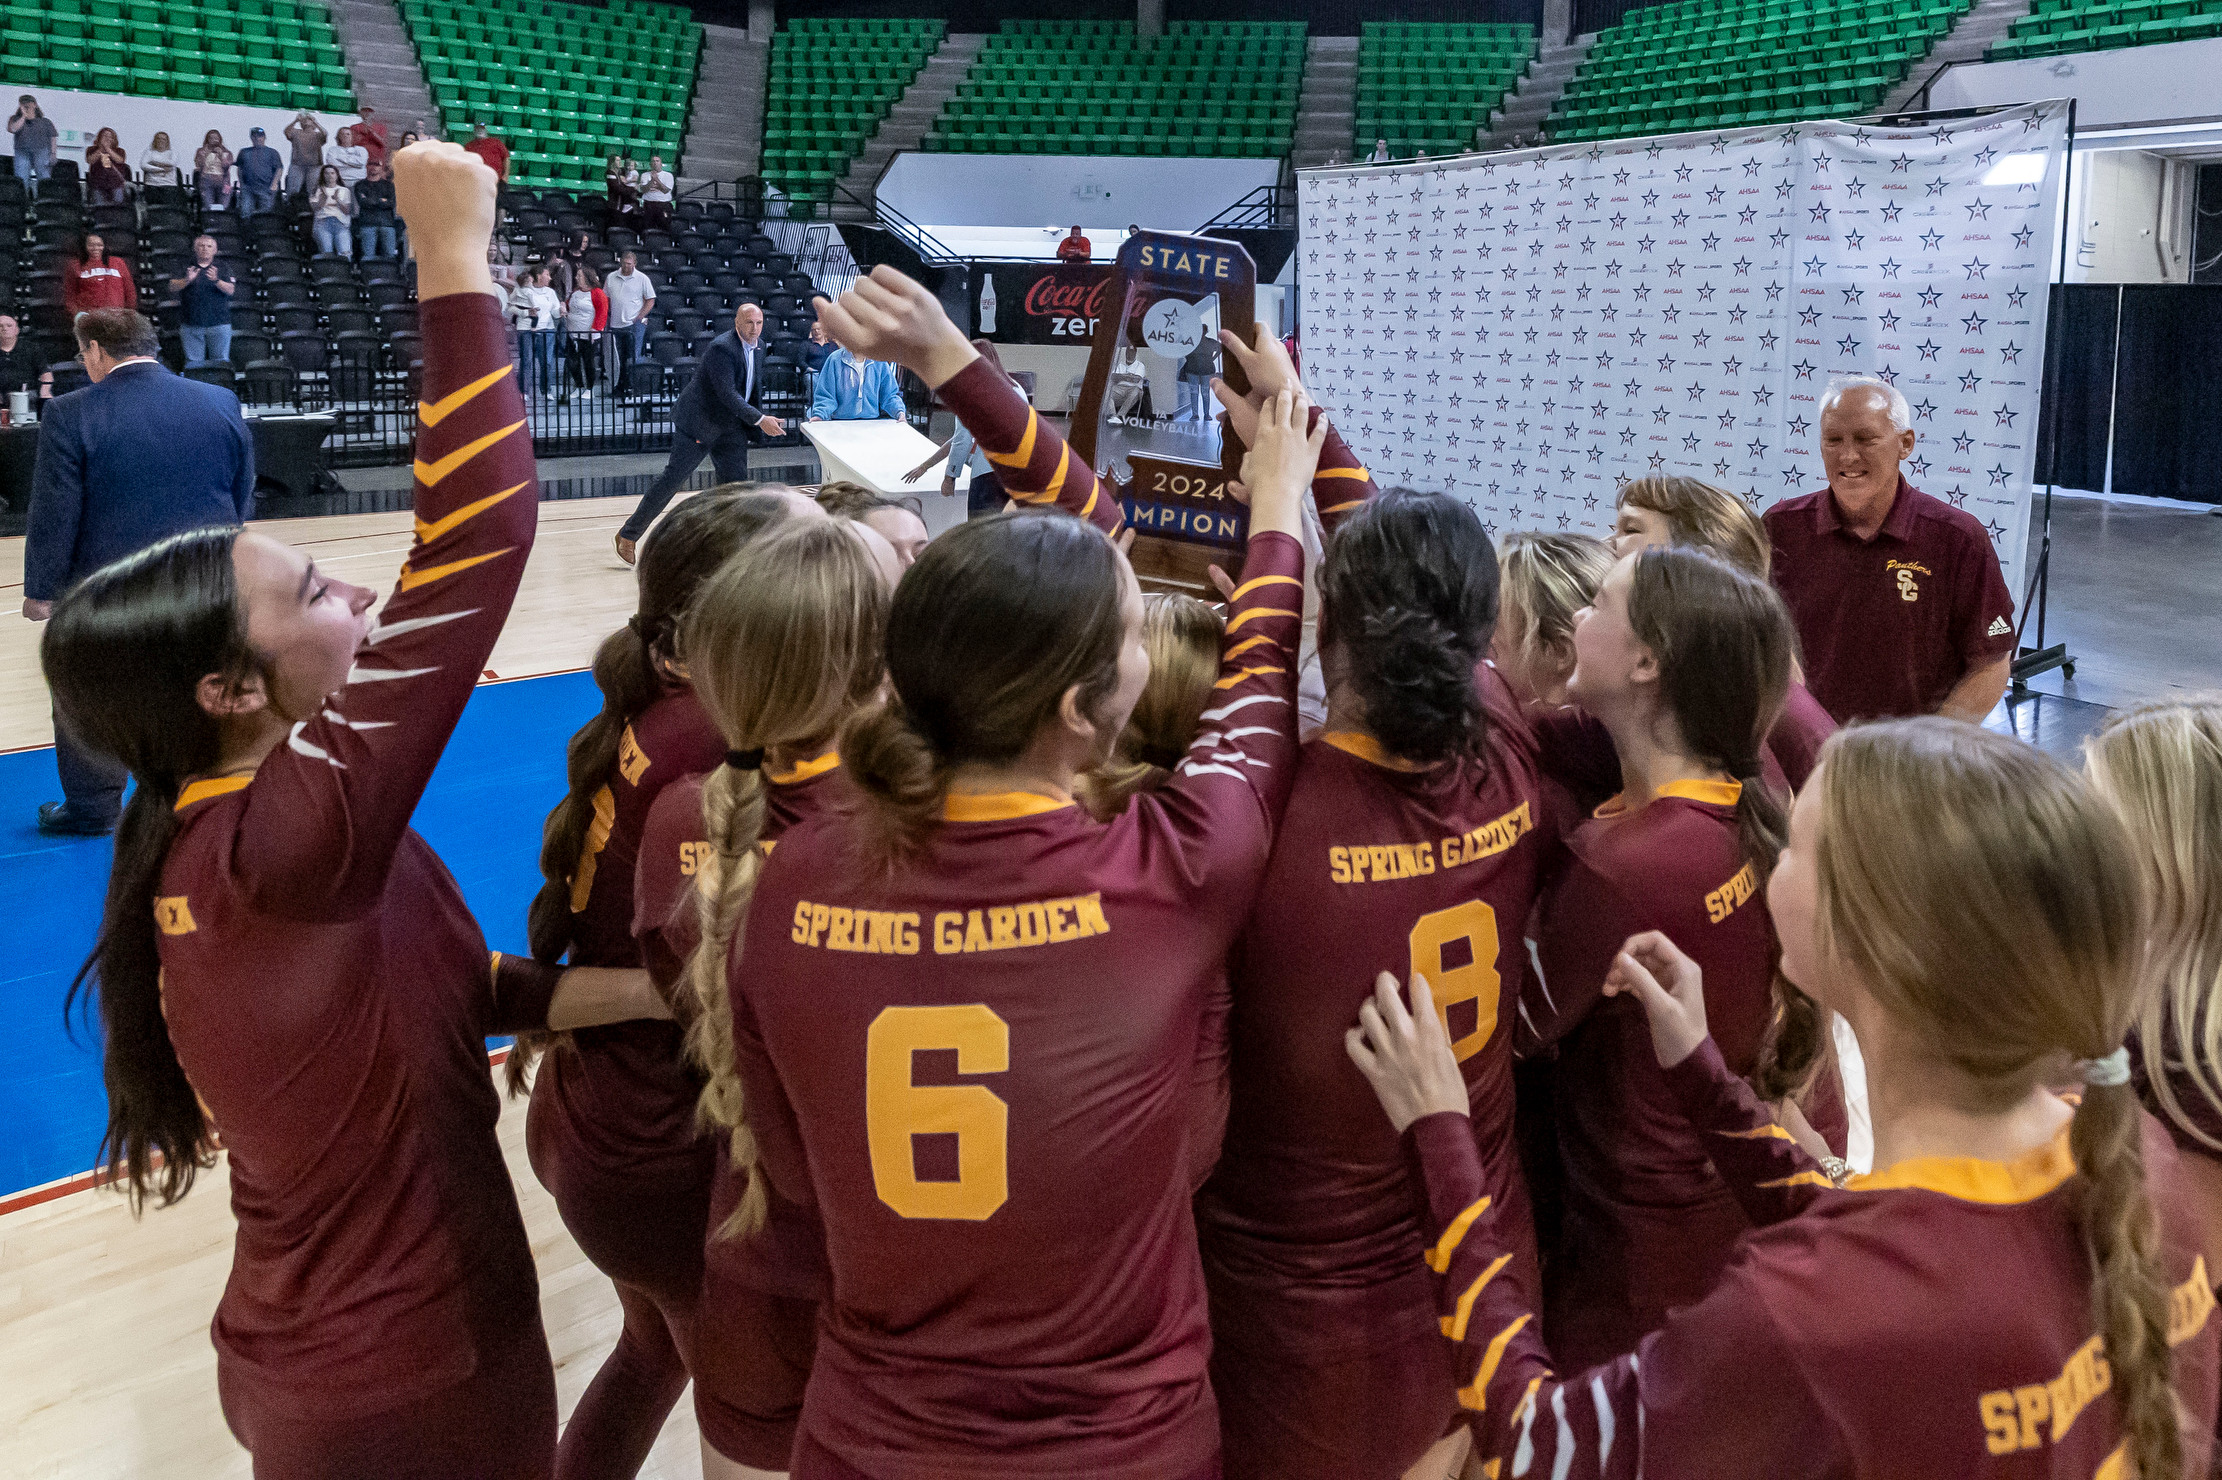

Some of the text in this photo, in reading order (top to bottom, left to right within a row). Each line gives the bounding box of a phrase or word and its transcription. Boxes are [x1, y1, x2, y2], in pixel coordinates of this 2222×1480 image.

[1141, 245, 1231, 278] STATE
[1051, 317, 1100, 336] zer
[1148, 330, 1195, 347] AHSA
[1122, 415, 1198, 437] VOLLEYBALL
[1152, 472, 1225, 501] 2024
[1119, 502, 1237, 537] MPION
[1886, 559, 1932, 576] Panthers
[1330, 800, 1534, 884] SPRING GARDEN
[791, 891, 1111, 955] SPRING GARDEN
[1408, 899, 1502, 1064] 8
[865, 1003, 1010, 1222] 6
